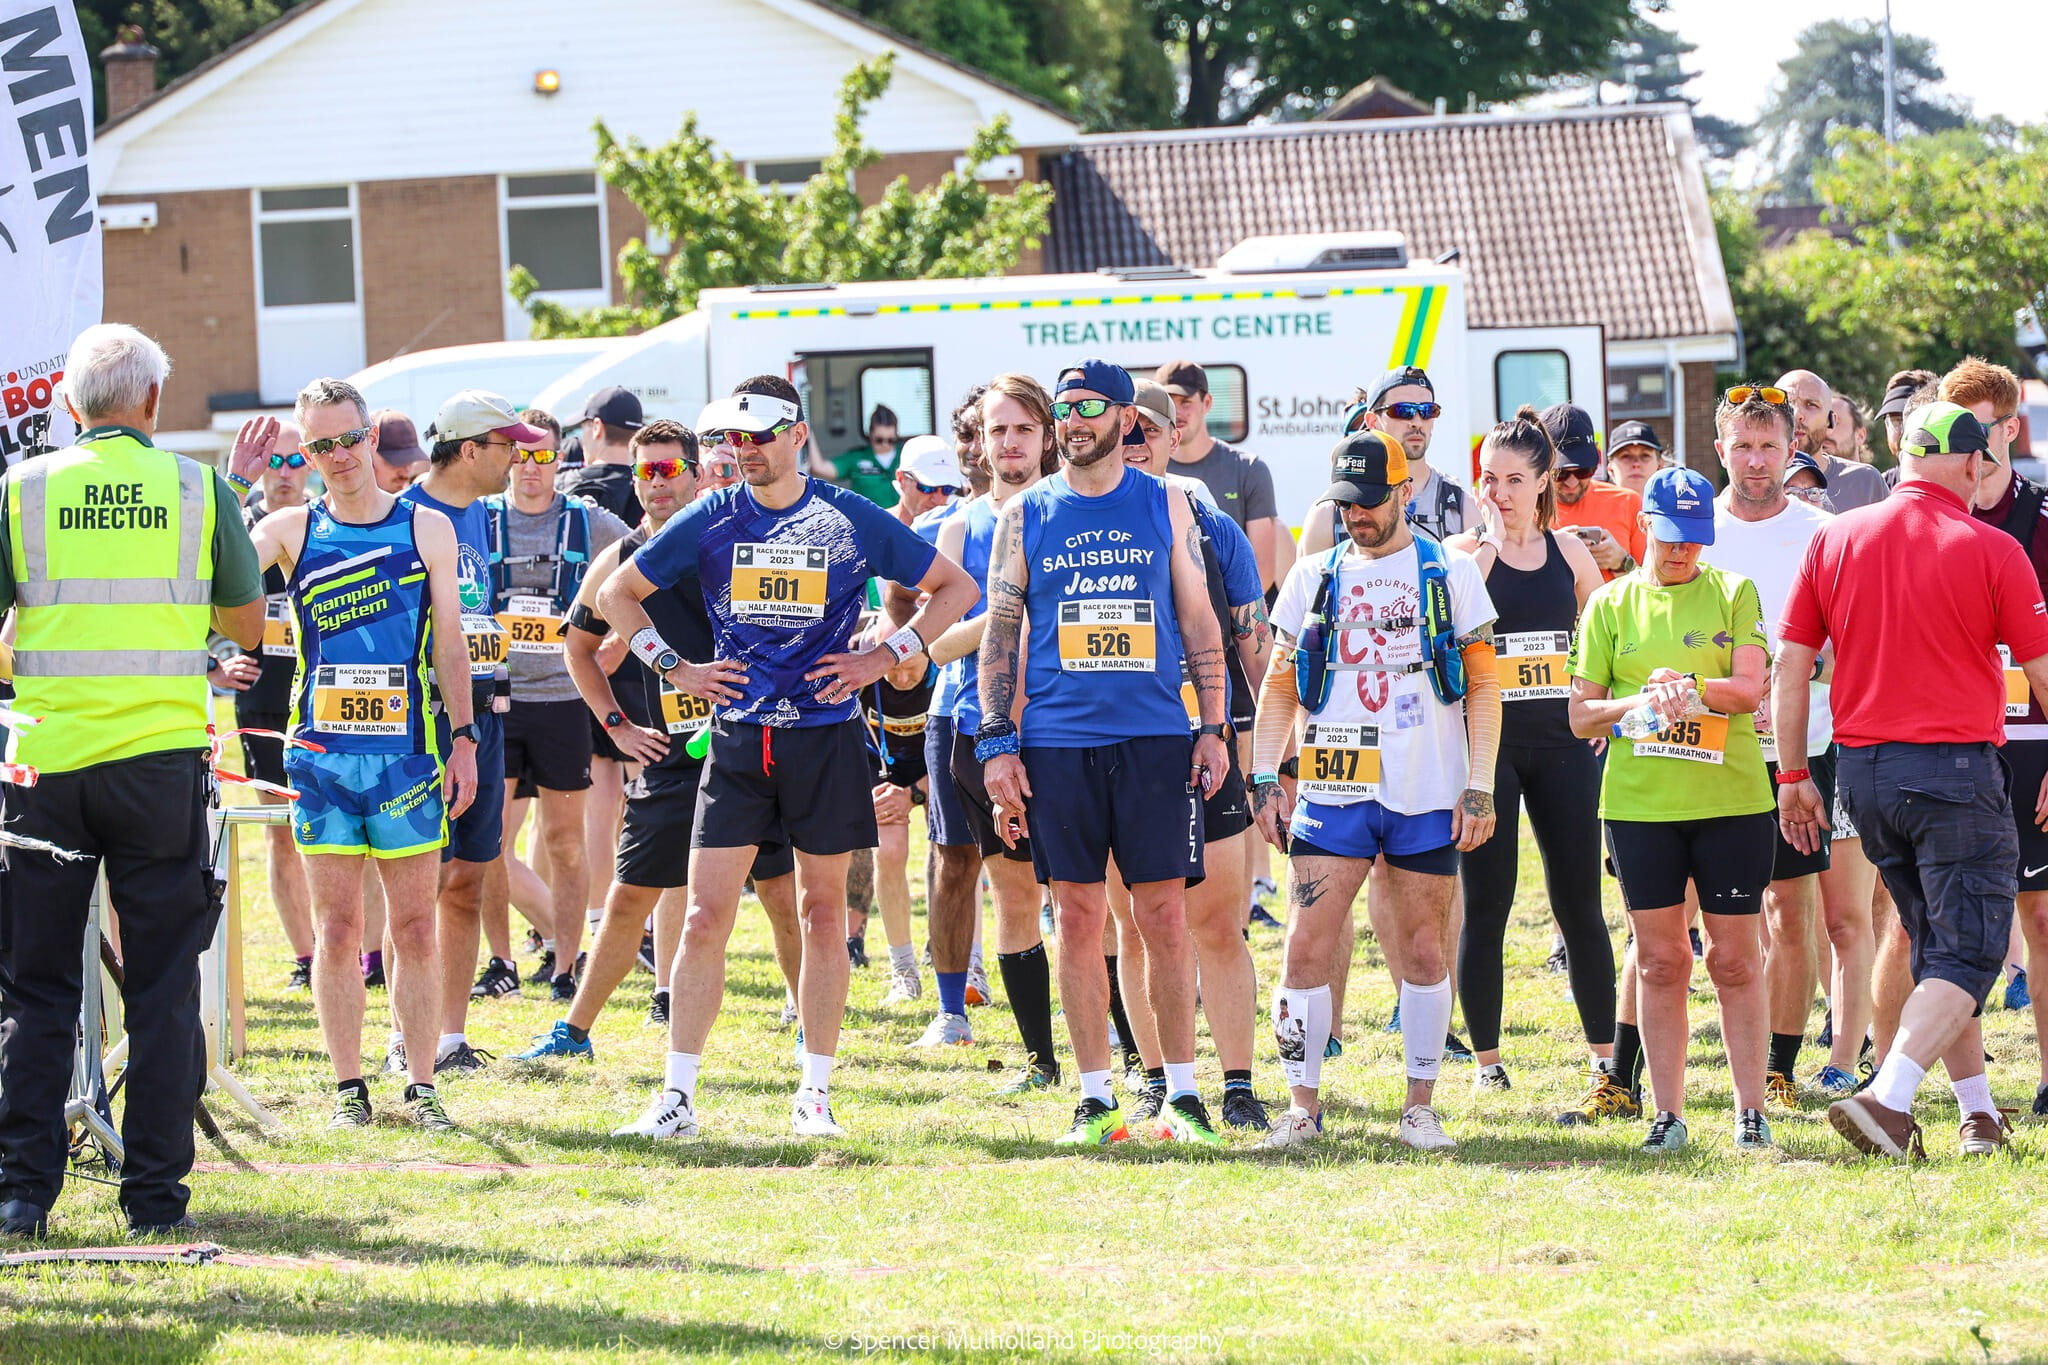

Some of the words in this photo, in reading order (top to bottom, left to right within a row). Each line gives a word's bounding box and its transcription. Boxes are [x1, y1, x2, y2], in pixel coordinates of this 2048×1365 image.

[0, 5, 94, 245] MEN
[1023, 316, 1202, 347] TREATMENT
[1212, 311, 1333, 340] CENTRE
[1257, 397, 1282, 418] St
[85, 483, 143, 505] RACE
[59, 506, 168, 530] DIRECTOR
[1065, 530, 1104, 549] CITY
[1108, 529, 1133, 543] OF
[769, 556, 794, 565] 2023
[1042, 548, 1154, 573] SALISBURY
[758, 576, 799, 602] 501
[1064, 571, 1138, 596] Jason
[317, 597, 388, 633] System
[748, 603, 768, 612] HALF
[769, 604, 813, 614] MARATHON
[1098, 611, 1122, 620] 2023
[511, 622, 545, 642] 523
[467, 633, 501, 662] 546
[1087, 632, 1131, 657] 526
[1523, 643, 1545, 651] 2023
[1079, 660, 1099, 669] HALF
[1101, 660, 1145, 669] MARATHON
[1518, 662, 1552, 686] 511
[352, 676, 377, 685] 2023
[1507, 690, 1528, 699] HALF
[1529, 688, 1564, 697] MARATHON
[340, 697, 384, 721] 536
[331, 723, 352, 732] HALF
[353, 724, 397, 733] MARATHON
[680, 722, 698, 731] HALF
[1327, 734, 1348, 743] 2023
[1647, 745, 1666, 754] HALF
[1667, 747, 1712, 760] MARATHON
[1315, 748, 1360, 781] 547
[379, 780, 427, 814] Champion
[1310, 783, 1327, 791] HALF
[1327, 784, 1368, 793] MARATHON
[389, 792, 429, 821] System
[1188, 797, 1198, 863] RUN
